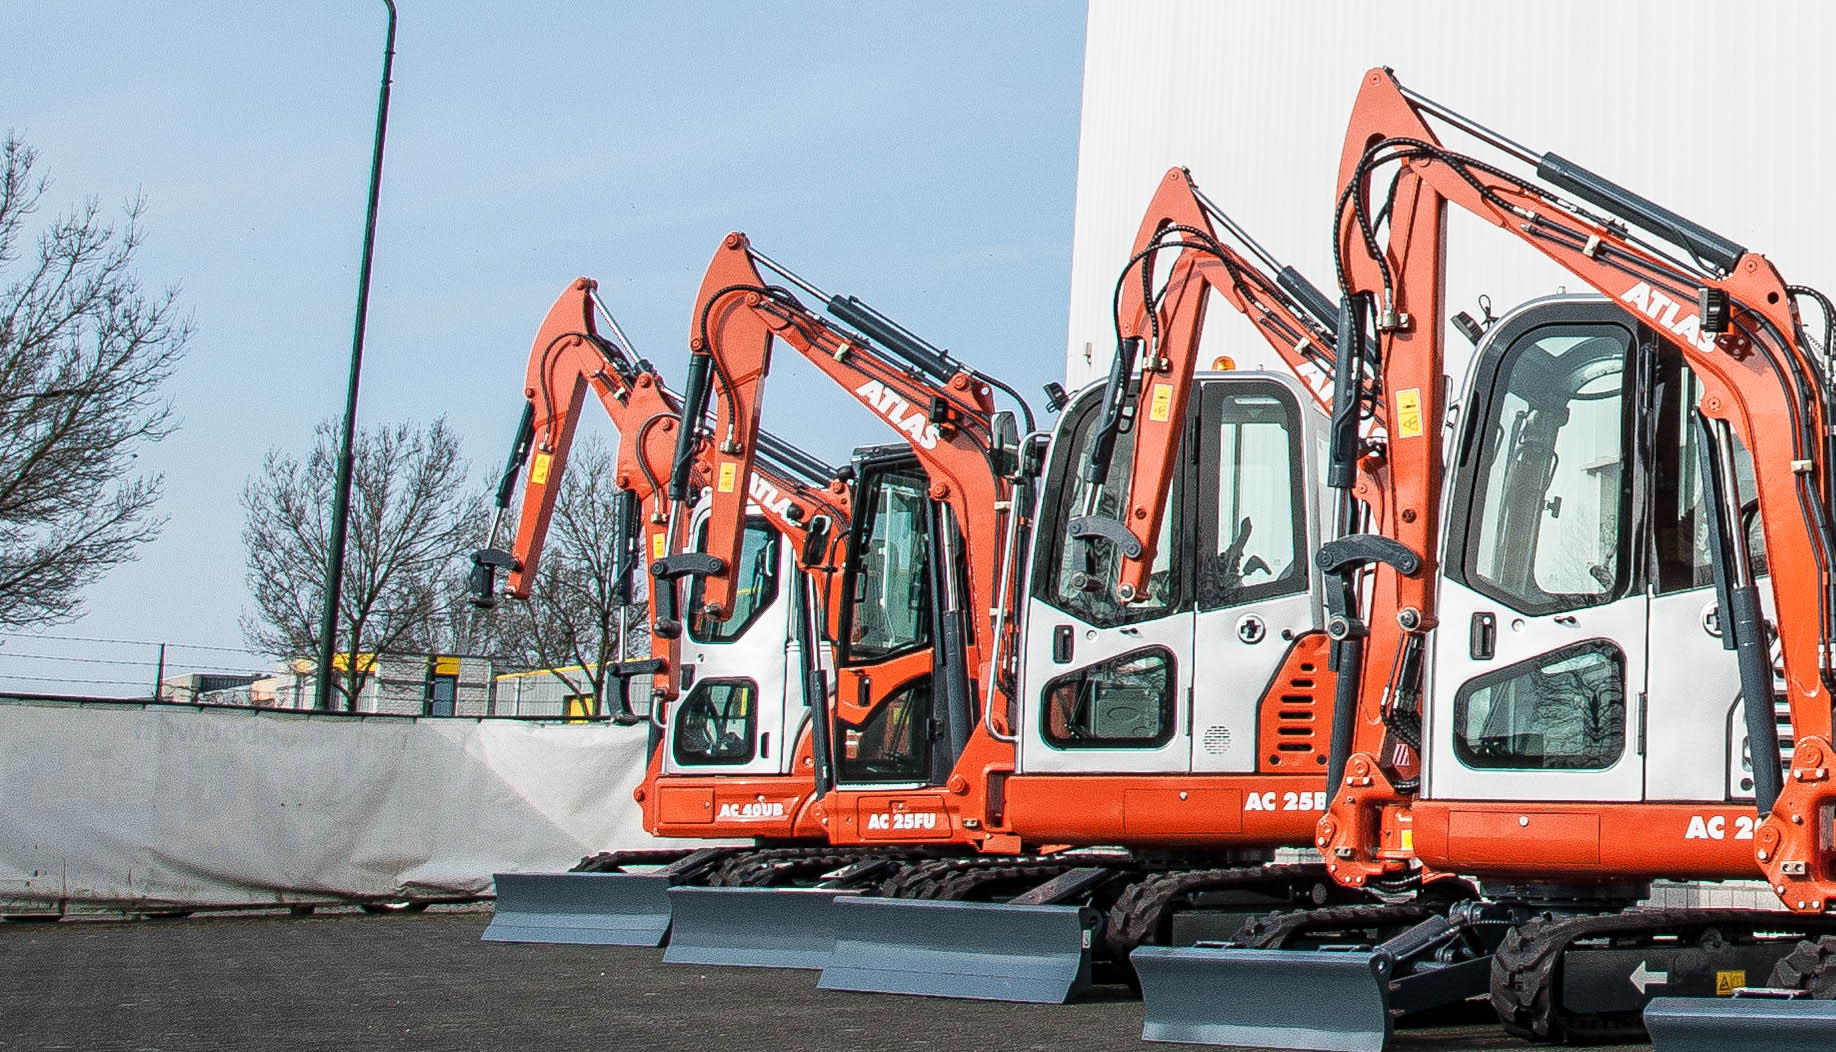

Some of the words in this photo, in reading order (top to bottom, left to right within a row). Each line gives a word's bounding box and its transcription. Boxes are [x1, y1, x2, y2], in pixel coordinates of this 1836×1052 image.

[1620, 281, 1717, 353] ATLAS
[855, 379, 941, 450] ATLAS
[719, 803, 739, 817] AC
[741, 802, 784, 817] 40UB
[1244, 791, 1277, 811] AC
[1282, 791, 1327, 811] 25B
[868, 813, 890, 829] AC
[893, 812, 936, 830] 25FU
[1684, 815, 1726, 840] AC
